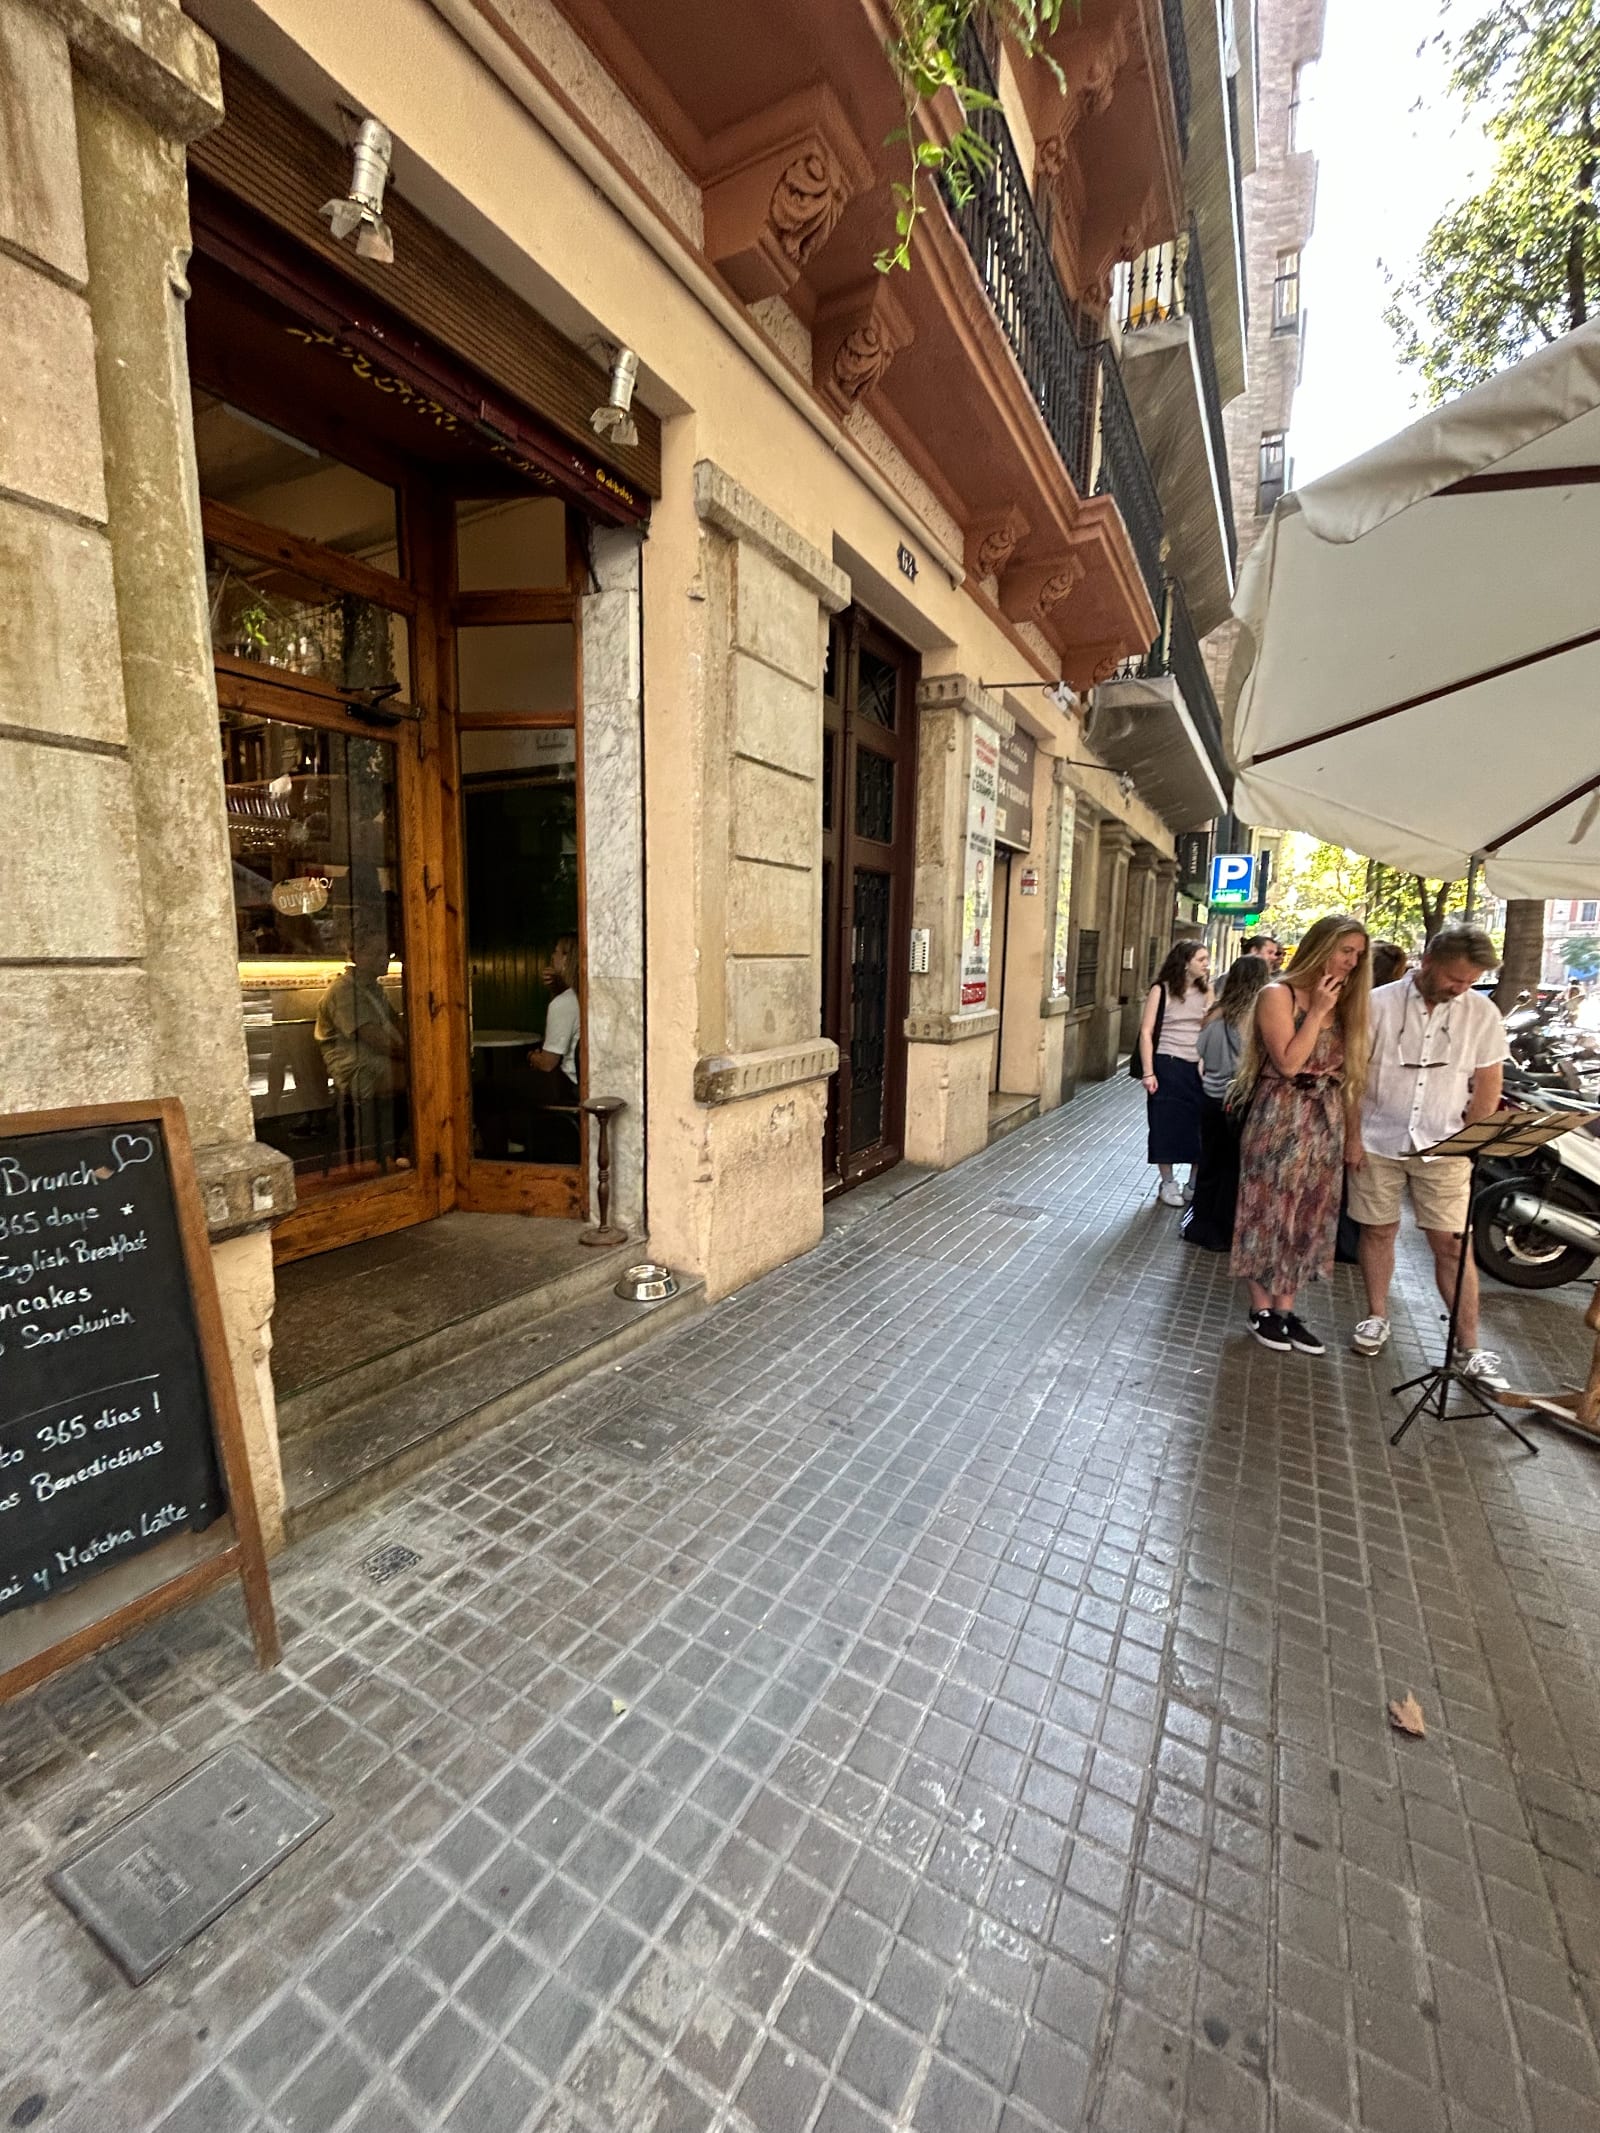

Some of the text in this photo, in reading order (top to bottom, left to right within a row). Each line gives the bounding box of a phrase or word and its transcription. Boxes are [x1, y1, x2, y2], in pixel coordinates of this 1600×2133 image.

[1218, 858, 1248, 889] P
[0, 1157, 99, 1196] Brunch
[45, 1206, 100, 1232] days
[20, 1307, 136, 1350] Sandwich
[36, 1414, 88, 1453] 365
[55, 1531, 137, 1574] Matcha
[140, 1503, 190, 1537] Latte
